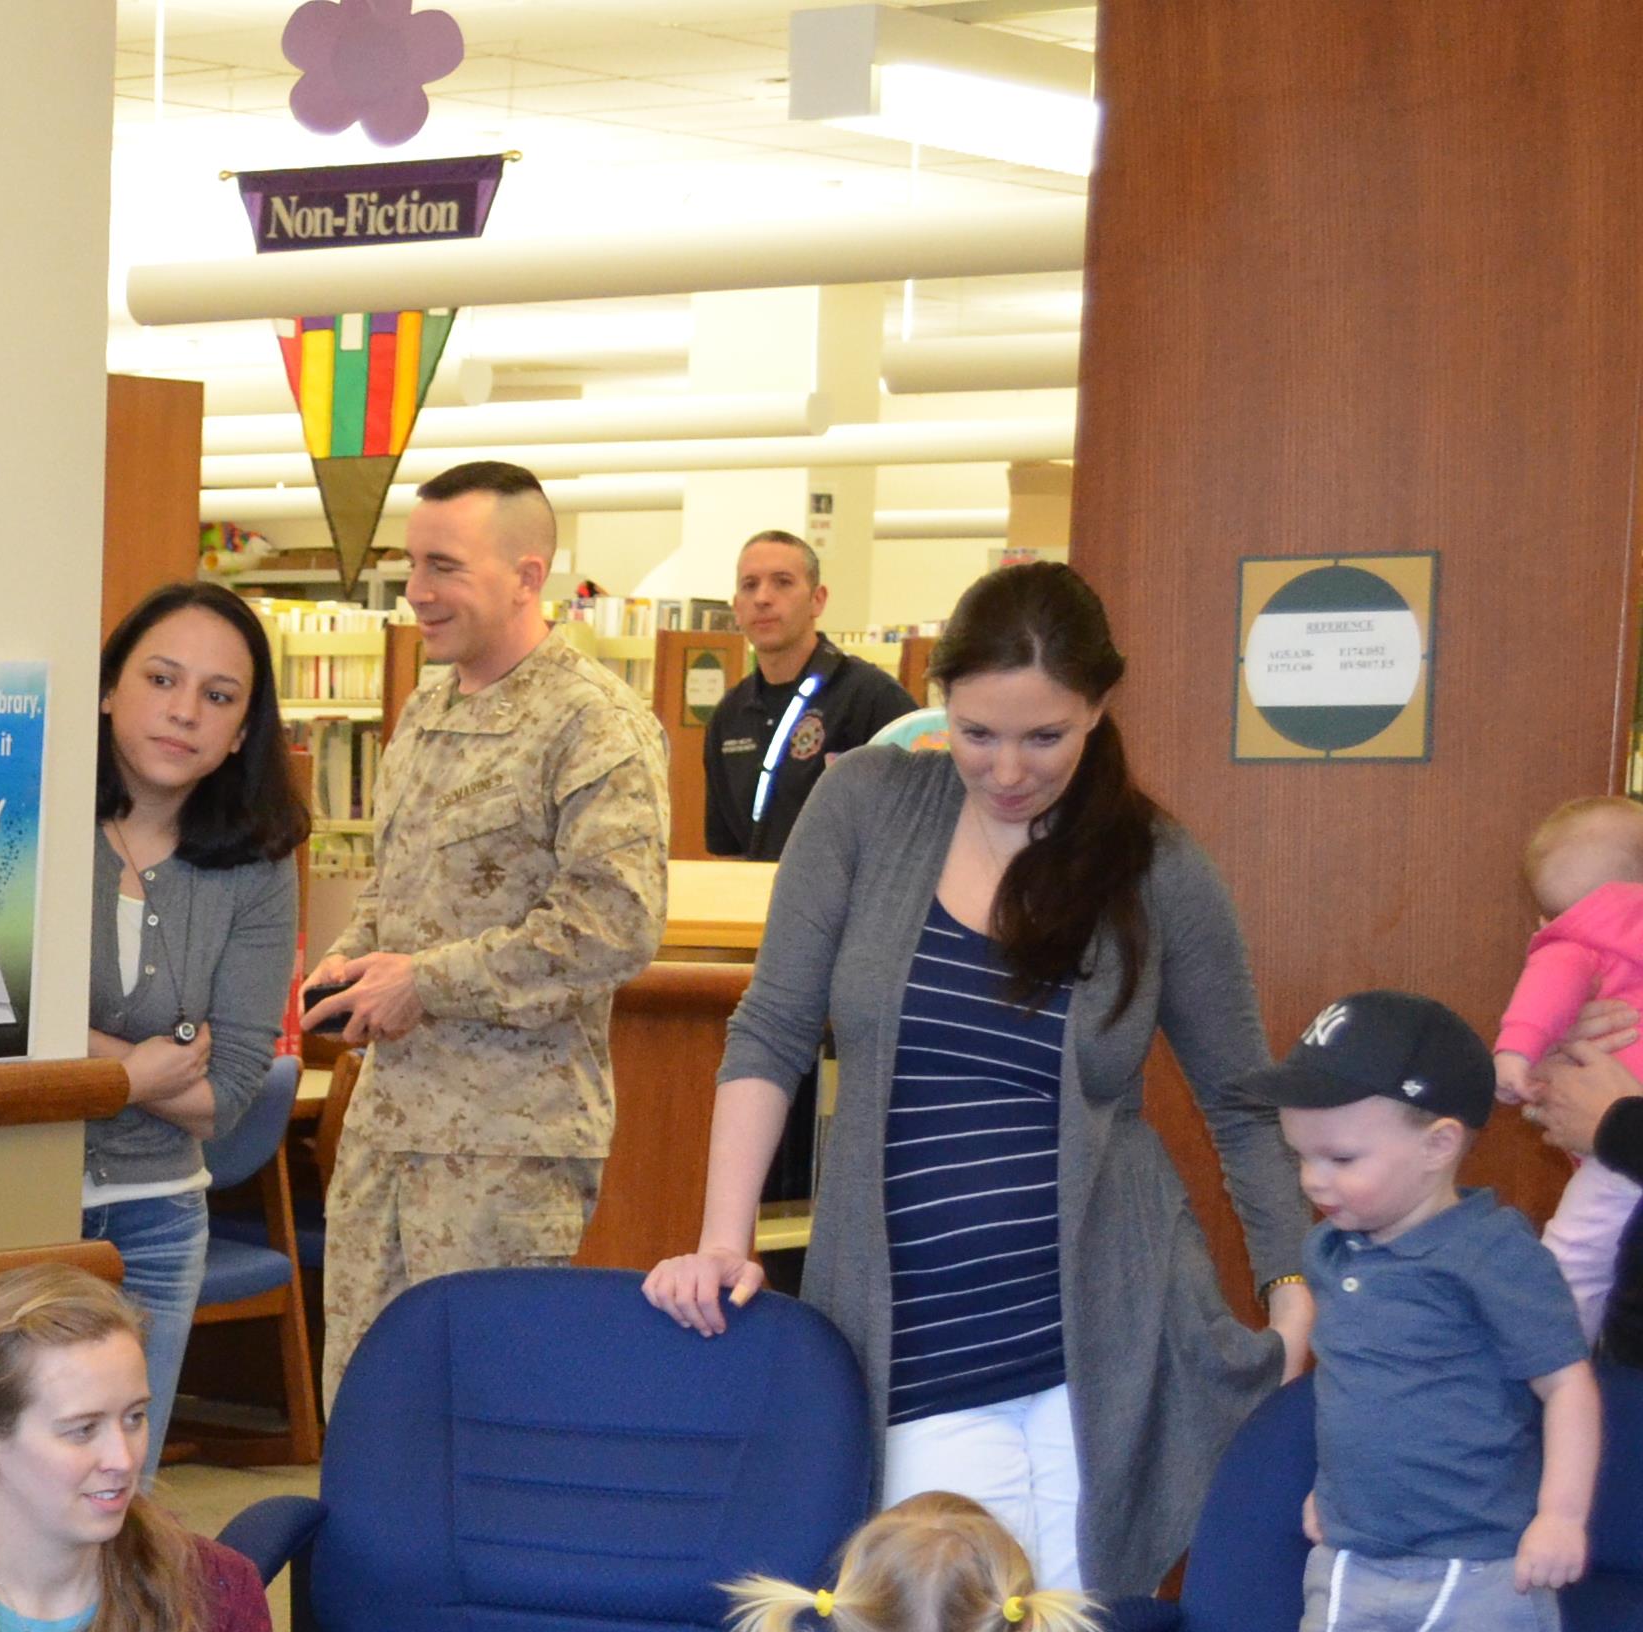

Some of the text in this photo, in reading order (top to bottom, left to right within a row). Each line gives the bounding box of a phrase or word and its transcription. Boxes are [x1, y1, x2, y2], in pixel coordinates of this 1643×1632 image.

[266, 189, 460, 239] Non-Fiction
[1306, 619, 1375, 634] REFERENCE
[0, 731, 13, 757] it
